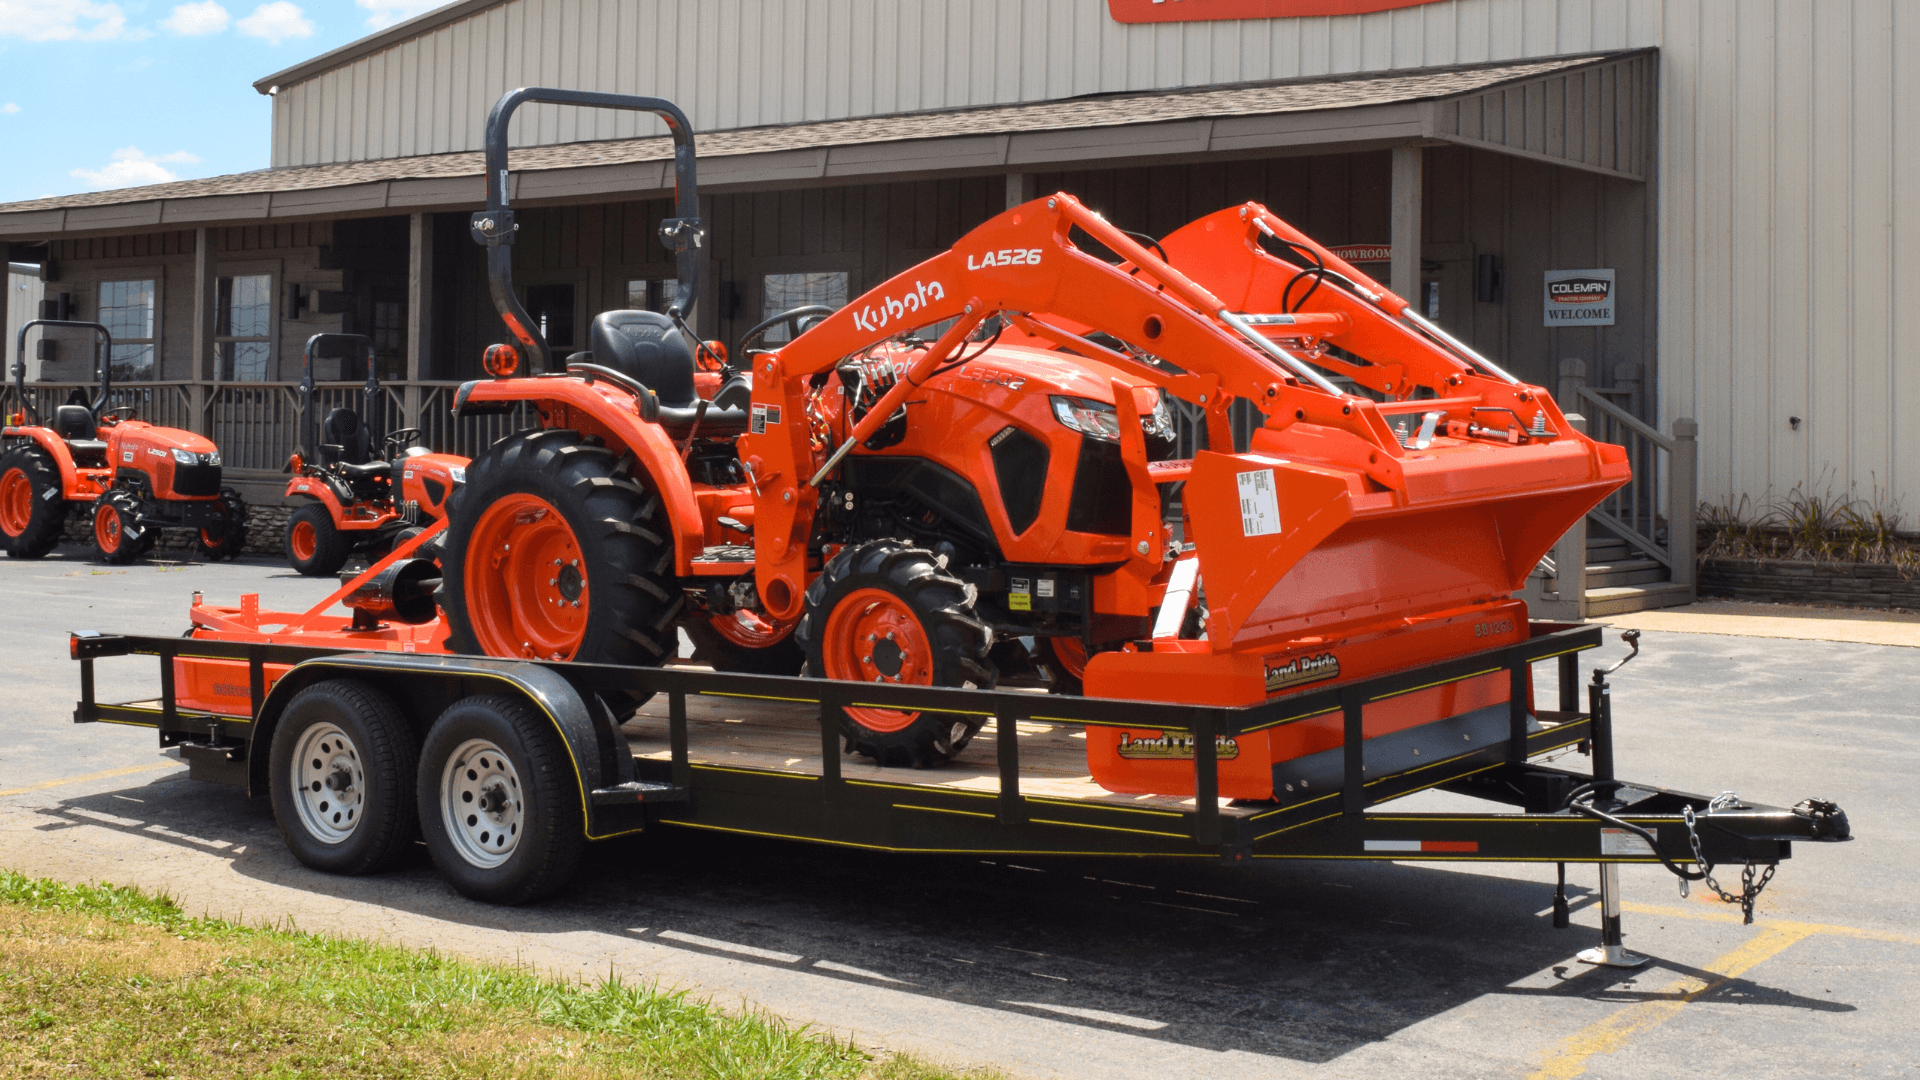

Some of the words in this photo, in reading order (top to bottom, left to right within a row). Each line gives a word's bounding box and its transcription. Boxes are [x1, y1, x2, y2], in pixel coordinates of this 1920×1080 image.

[968, 249, 1042, 271] LA526
[1332, 248, 1391, 259] HOWROOM
[1551, 282, 1607, 293] COLEMAN
[853, 281, 945, 332] Kubota
[1548, 308, 1610, 319] WELCOME
[956, 365, 1026, 391] L3302
[147, 447, 167, 458] L2501
[1474, 619, 1514, 637] BB1260
[1300, 653, 1338, 676] Pride
[213, 682, 252, 698] RCR126
[1120, 733, 1168, 752] Land
[1183, 733, 1237, 752] Pde
